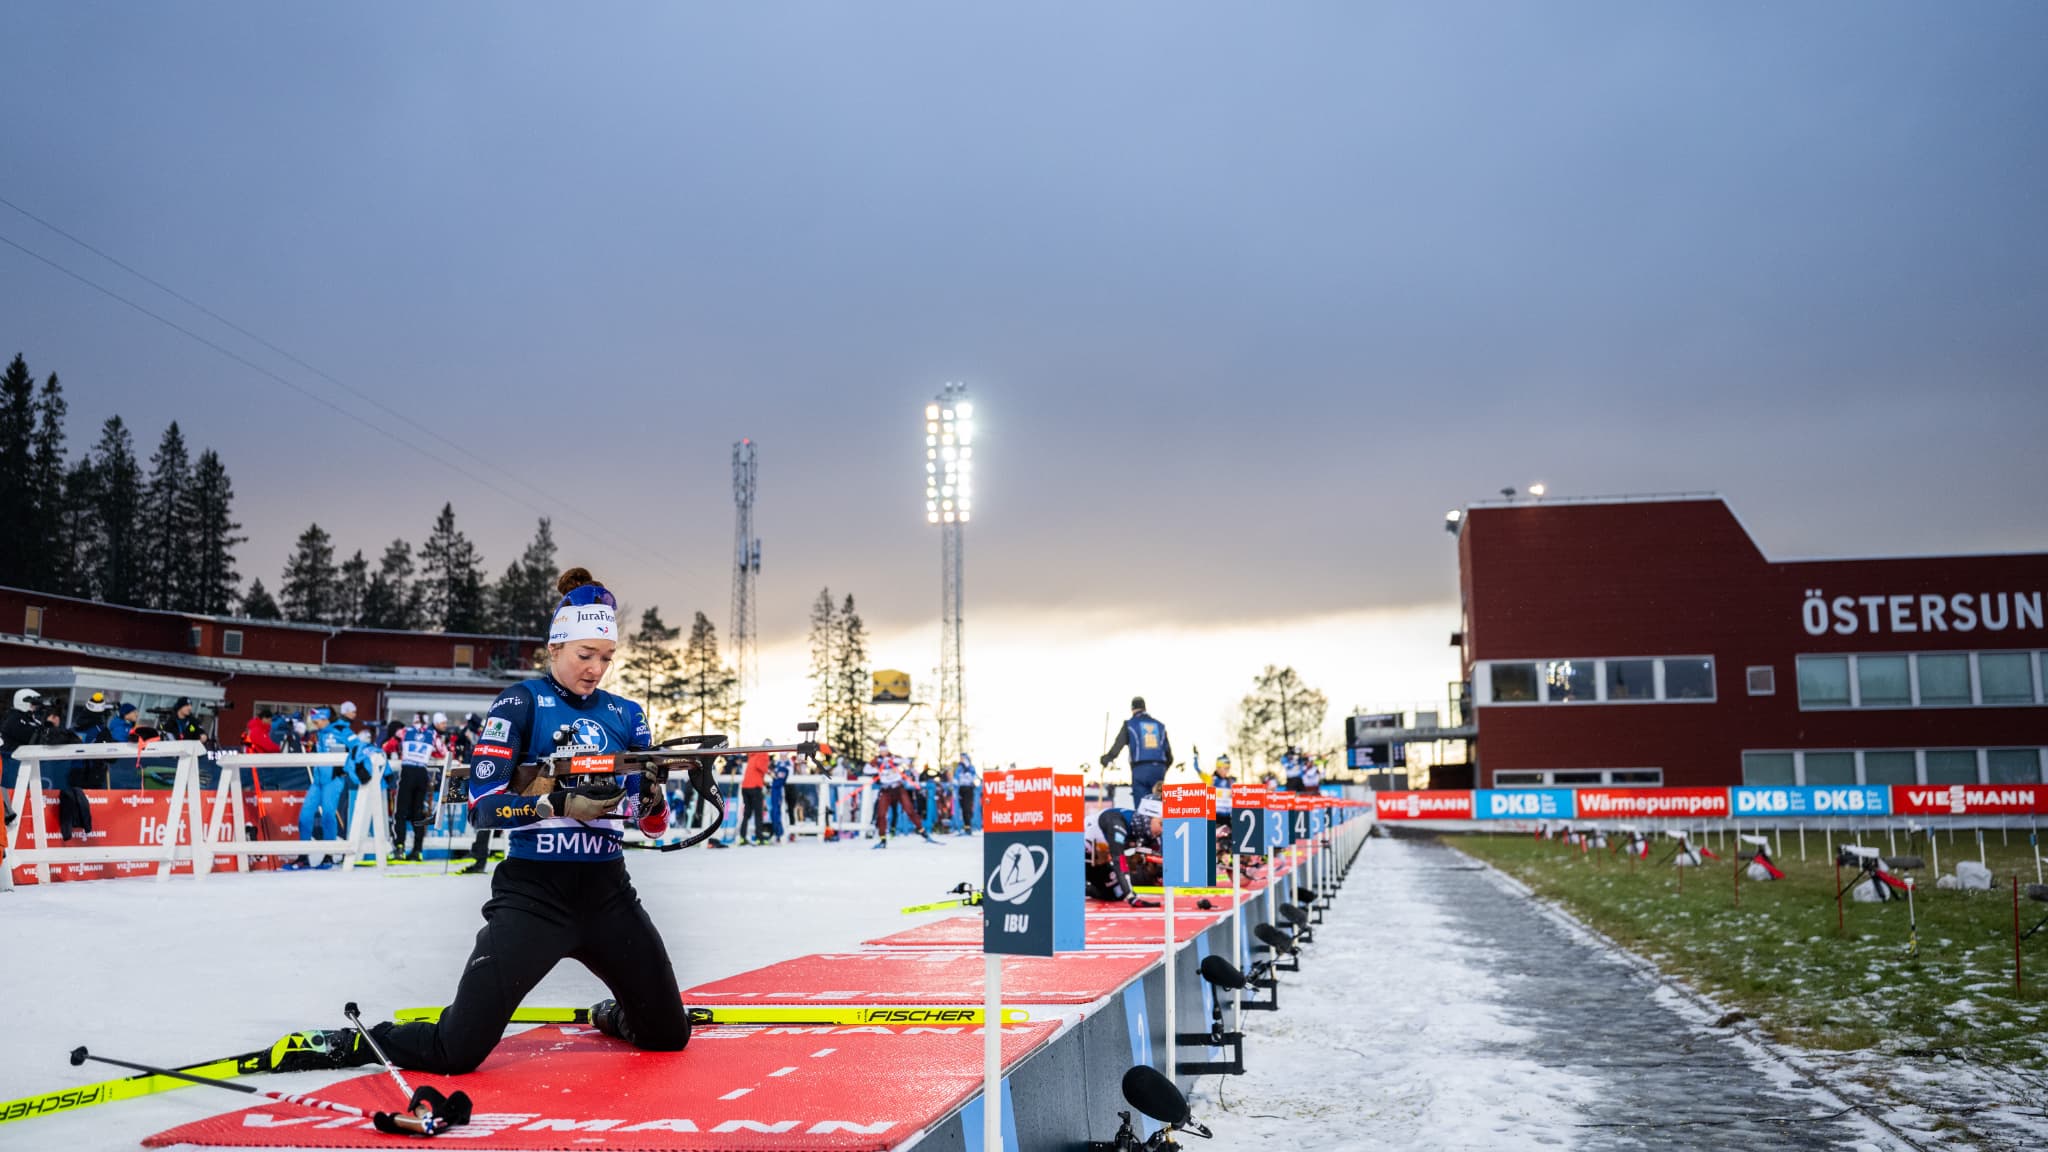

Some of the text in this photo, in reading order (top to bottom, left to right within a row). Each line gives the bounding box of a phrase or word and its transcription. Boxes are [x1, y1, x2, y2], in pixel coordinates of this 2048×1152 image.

[573, 757, 614, 768] VIESSMANN
[984, 774, 1052, 801] VIESSMANN
[1163, 786, 1206, 802] VIESSMANN
[1378, 794, 1469, 817] VIESSMANN
[1491, 794, 1540, 815] DKB
[1580, 794, 1725, 814] Wärmepumpen
[1738, 790, 1788, 811] DKB
[1813, 790, 1864, 811] DKB
[1907, 785, 2035, 813] VIESSMANN
[496, 805, 537, 818] somfy
[991, 811, 1044, 826] Heat pumps
[1182, 807, 1200, 815] pumps
[1240, 809, 1255, 853] 2
[1271, 812, 1283, 846] 3
[1294, 811, 1306, 838] 4
[537, 832, 603, 854] BMW
[1175, 821, 1190, 882] 1
[1003, 914, 1029, 933] IBU
[868, 1010, 976, 1022] FISCHER
